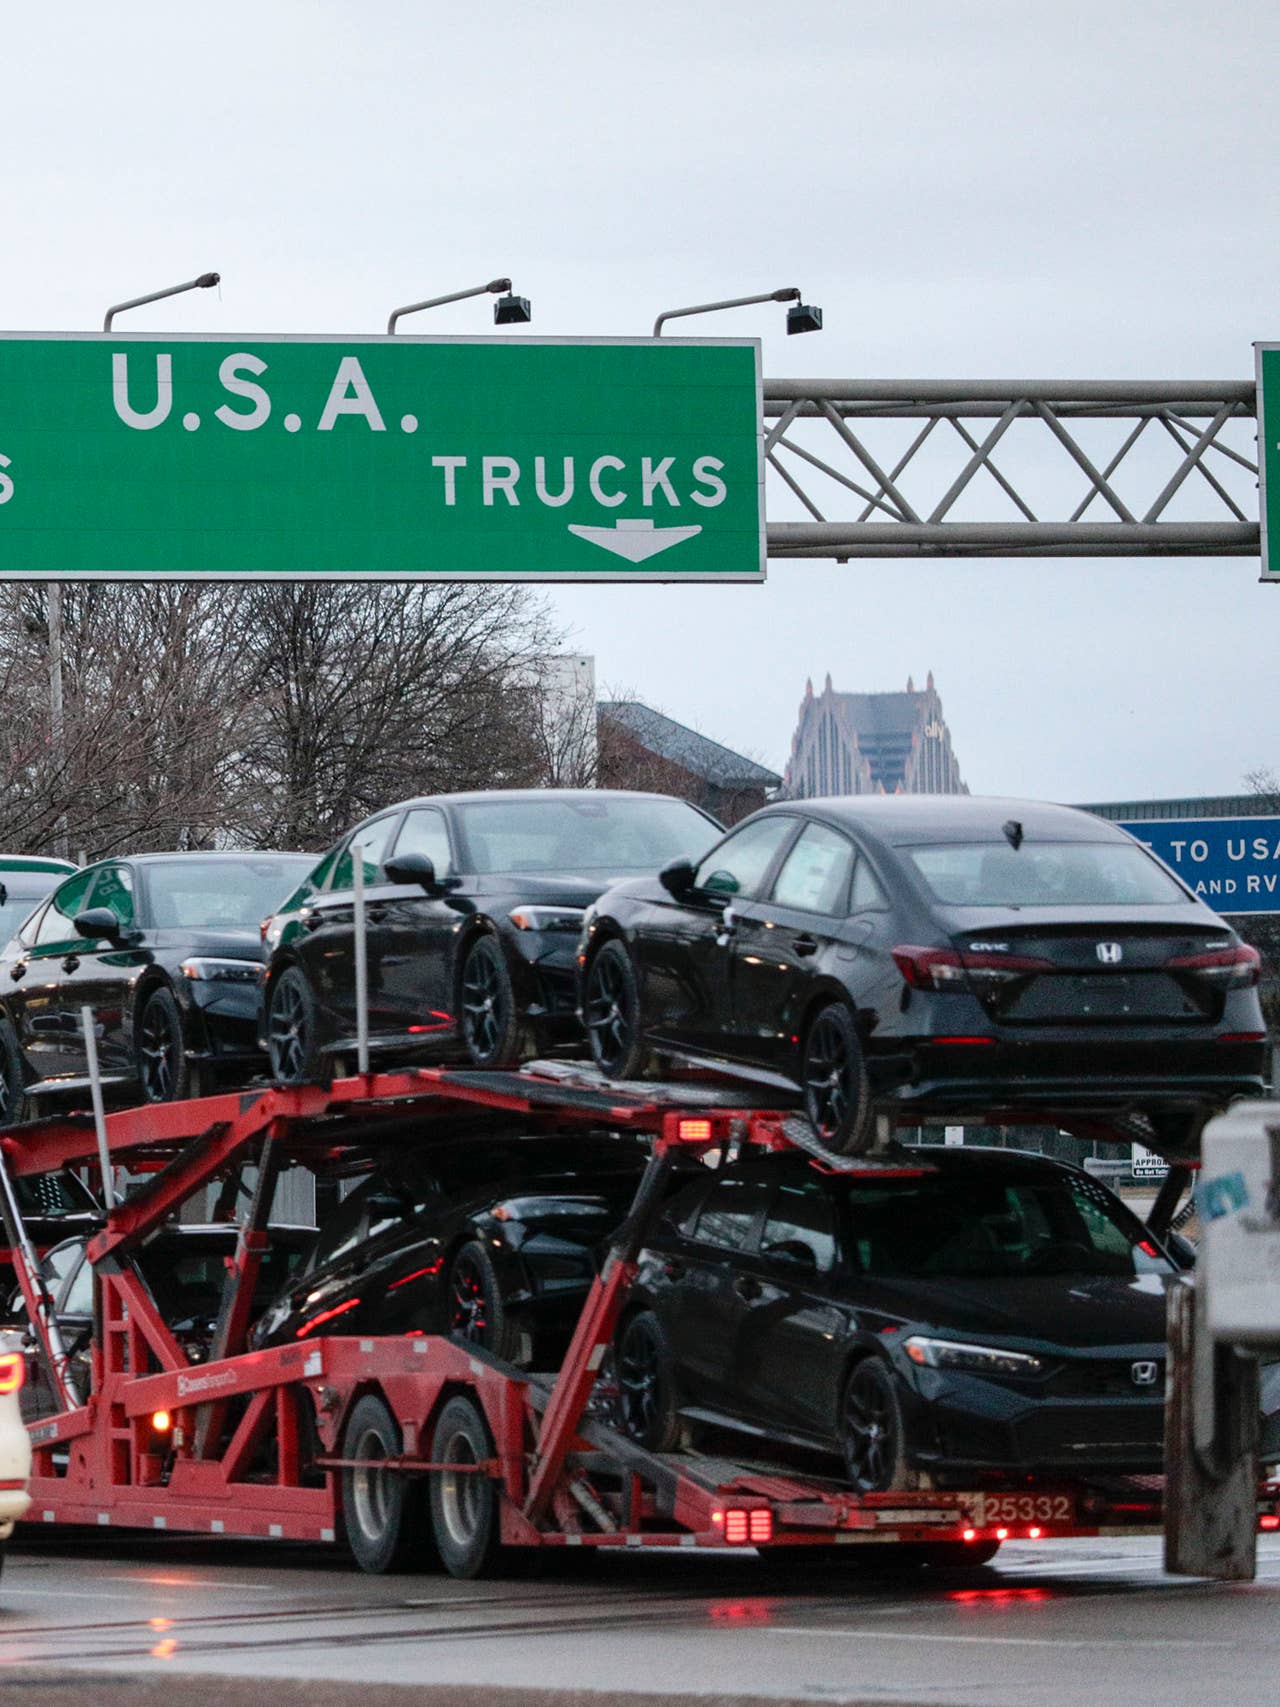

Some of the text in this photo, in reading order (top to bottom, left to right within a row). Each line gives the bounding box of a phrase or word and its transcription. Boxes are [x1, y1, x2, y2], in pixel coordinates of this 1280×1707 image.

[113, 353, 417, 432] U.S.A.
[432, 456, 726, 506] TRUCKS
[924, 721, 944, 742] ally
[1170, 840, 1209, 862] TO
[1195, 879, 1237, 894] AND
[969, 942, 1009, 952] CIVIC
[985, 1496, 1070, 1521] 25332
